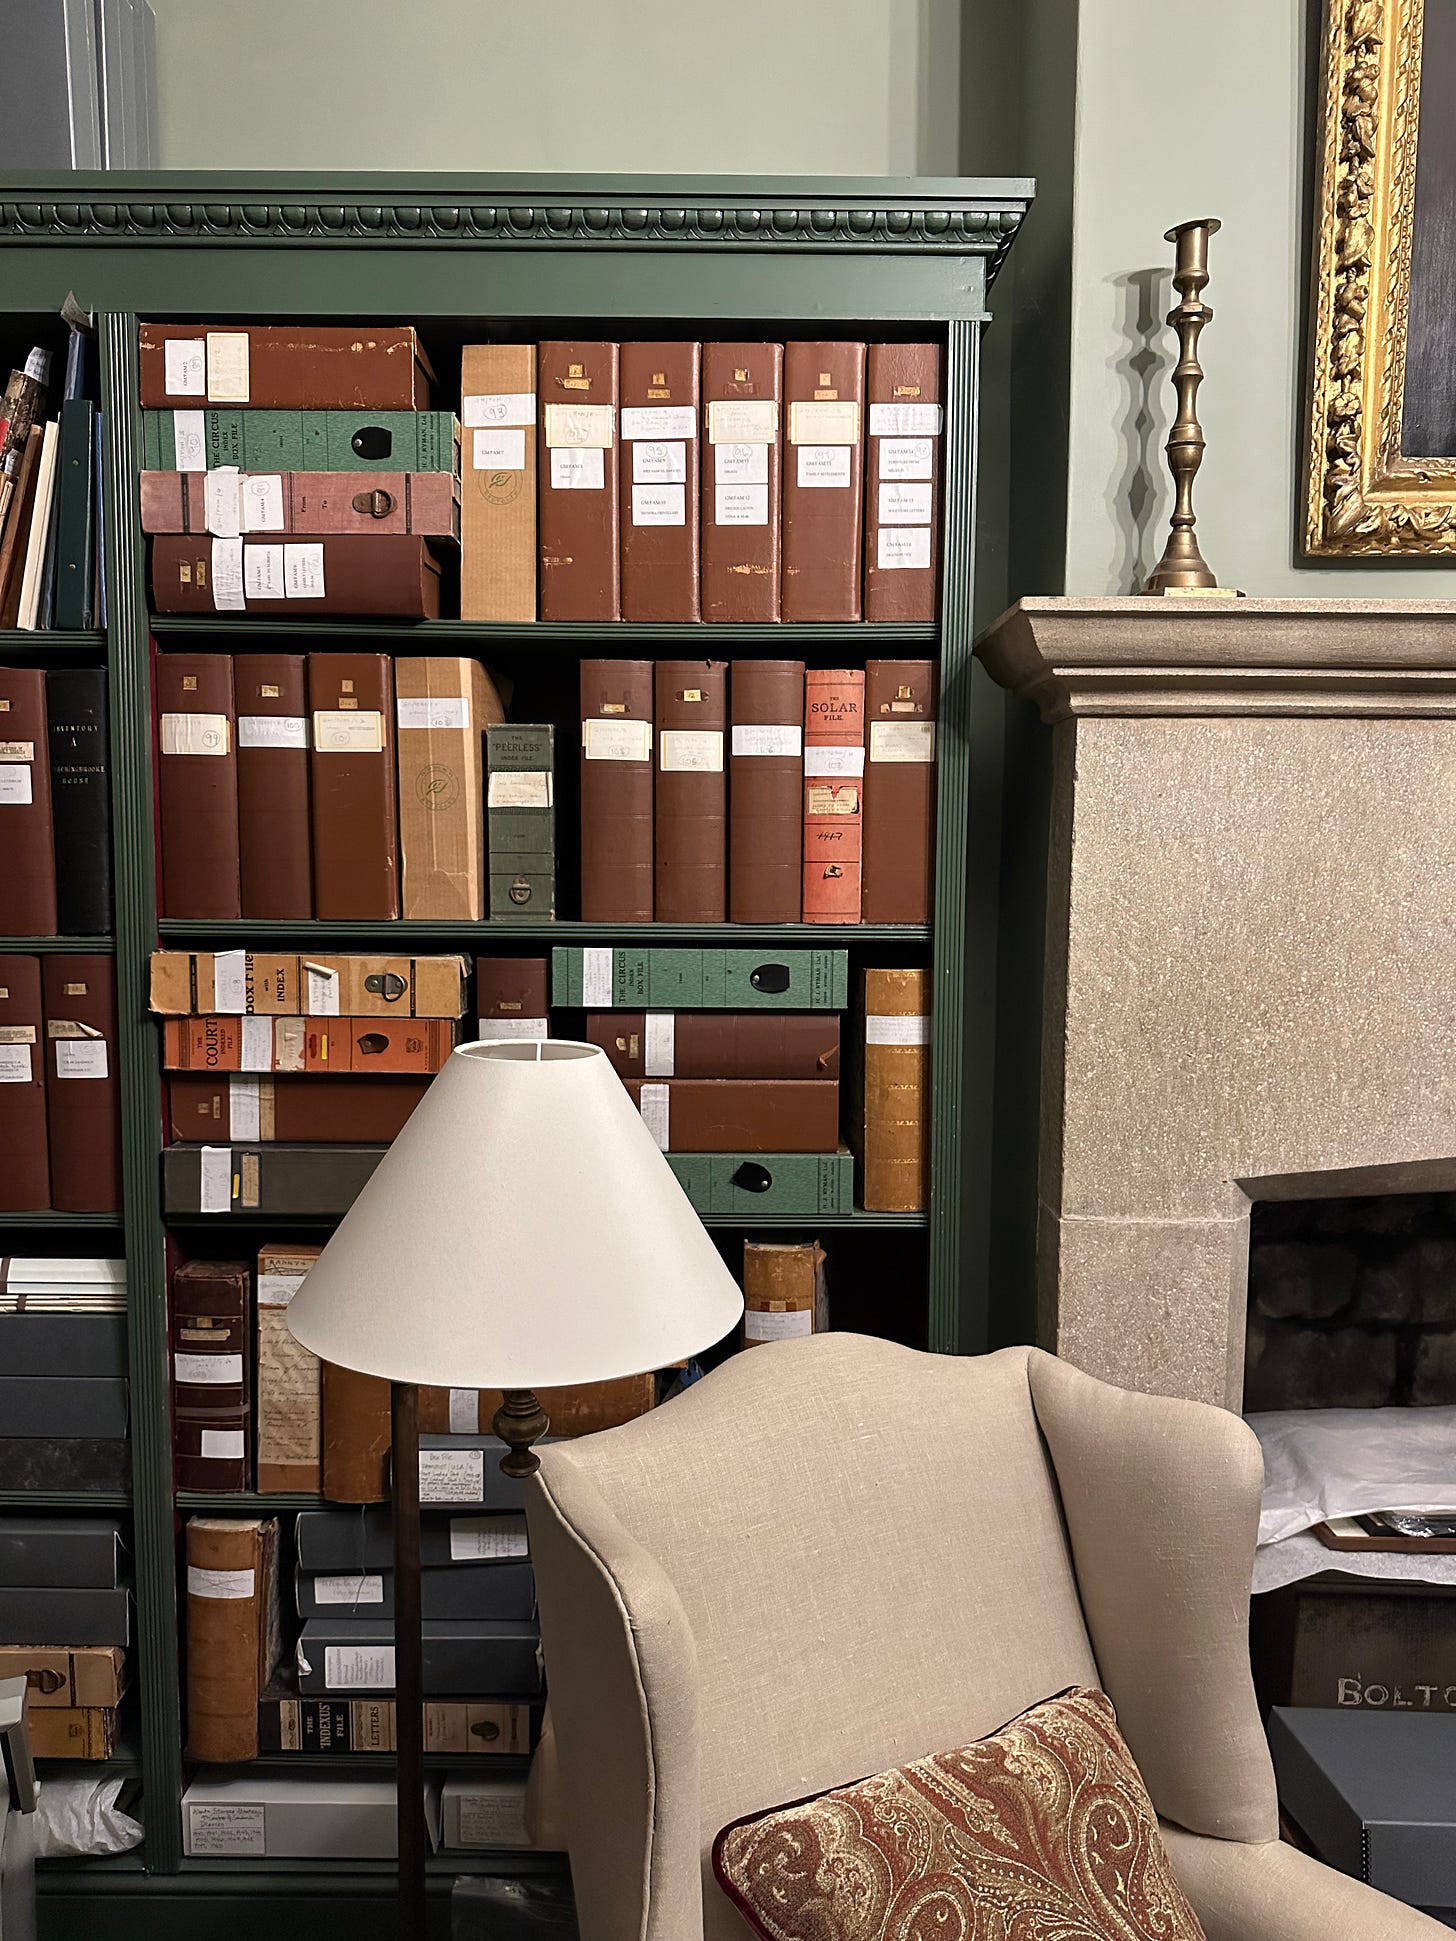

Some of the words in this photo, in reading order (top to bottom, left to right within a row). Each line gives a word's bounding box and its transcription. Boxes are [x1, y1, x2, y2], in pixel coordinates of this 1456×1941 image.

[211, 412, 220, 449] CIRCUS
[321, 500, 328, 510] To
[811, 702, 858, 713] SOLAR
[205, 732, 219, 746] 99
[493, 743, 543, 752] "PEERLESS"
[618, 951, 626, 985] CIRCUS
[276, 968, 285, 1002] INDEX
[206, 1019, 219, 1066] COURT
[306, 1715, 314, 1735] THE
[336, 1713, 344, 1737] FILE
[370, 1706, 380, 1746] LETTERS
